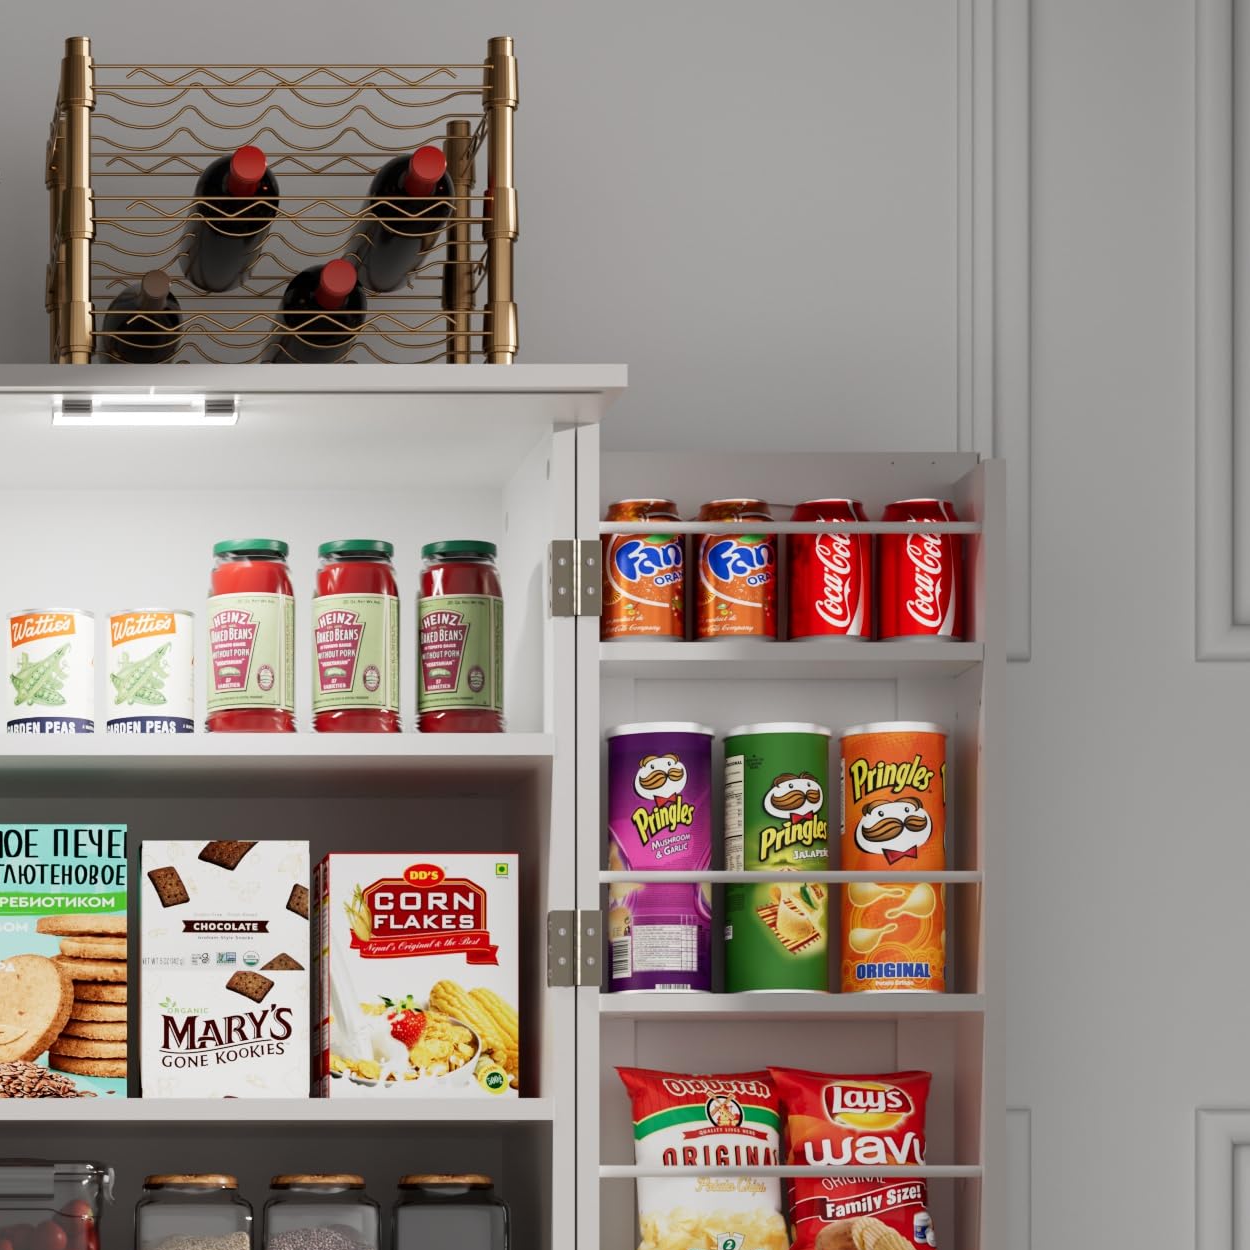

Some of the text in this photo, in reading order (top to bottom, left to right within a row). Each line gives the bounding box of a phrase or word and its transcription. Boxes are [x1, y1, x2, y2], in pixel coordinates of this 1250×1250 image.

[112, 614, 171, 641] Wattie's
[214, 612, 248, 627] HEINZ
[319, 612, 353, 628] HEINZ
[423, 613, 458, 629] HEINZ
[12, 614, 71, 642] Wattie's
[229, 628, 252, 640] BEANS
[335, 628, 358, 641] BEANS
[439, 629, 463, 642] BEANS
[233, 648, 250, 656] PORK
[339, 649, 356, 657] PORK
[45, 720, 76, 733] PEAS
[146, 720, 176, 733] PEAS
[849, 753, 935, 804] Pringles
[632, 794, 695, 846] Pringles
[758, 814, 828, 861] Pringles
[655, 850, 663, 859] &
[410, 870, 439, 880] DD'S
[374, 892, 475, 911] CORN
[193, 922, 259, 931] CHOCOLATE
[373, 914, 475, 929] FLAKES
[363, 944, 396, 955] Nepal's
[398, 941, 433, 953] Original
[444, 938, 456, 946] the
[458, 937, 481, 946] Best
[856, 962, 931, 980] ORIGINAL
[161, 1004, 293, 1051] MARY'S
[161, 1042, 286, 1069] GONE KOOKIES
[662, 1079, 771, 1099] Old Dutch
[832, 1085, 903, 1114] Lay's
[826, 1185, 922, 1218] Family Size!
[725, 1240, 733, 1250] 2
